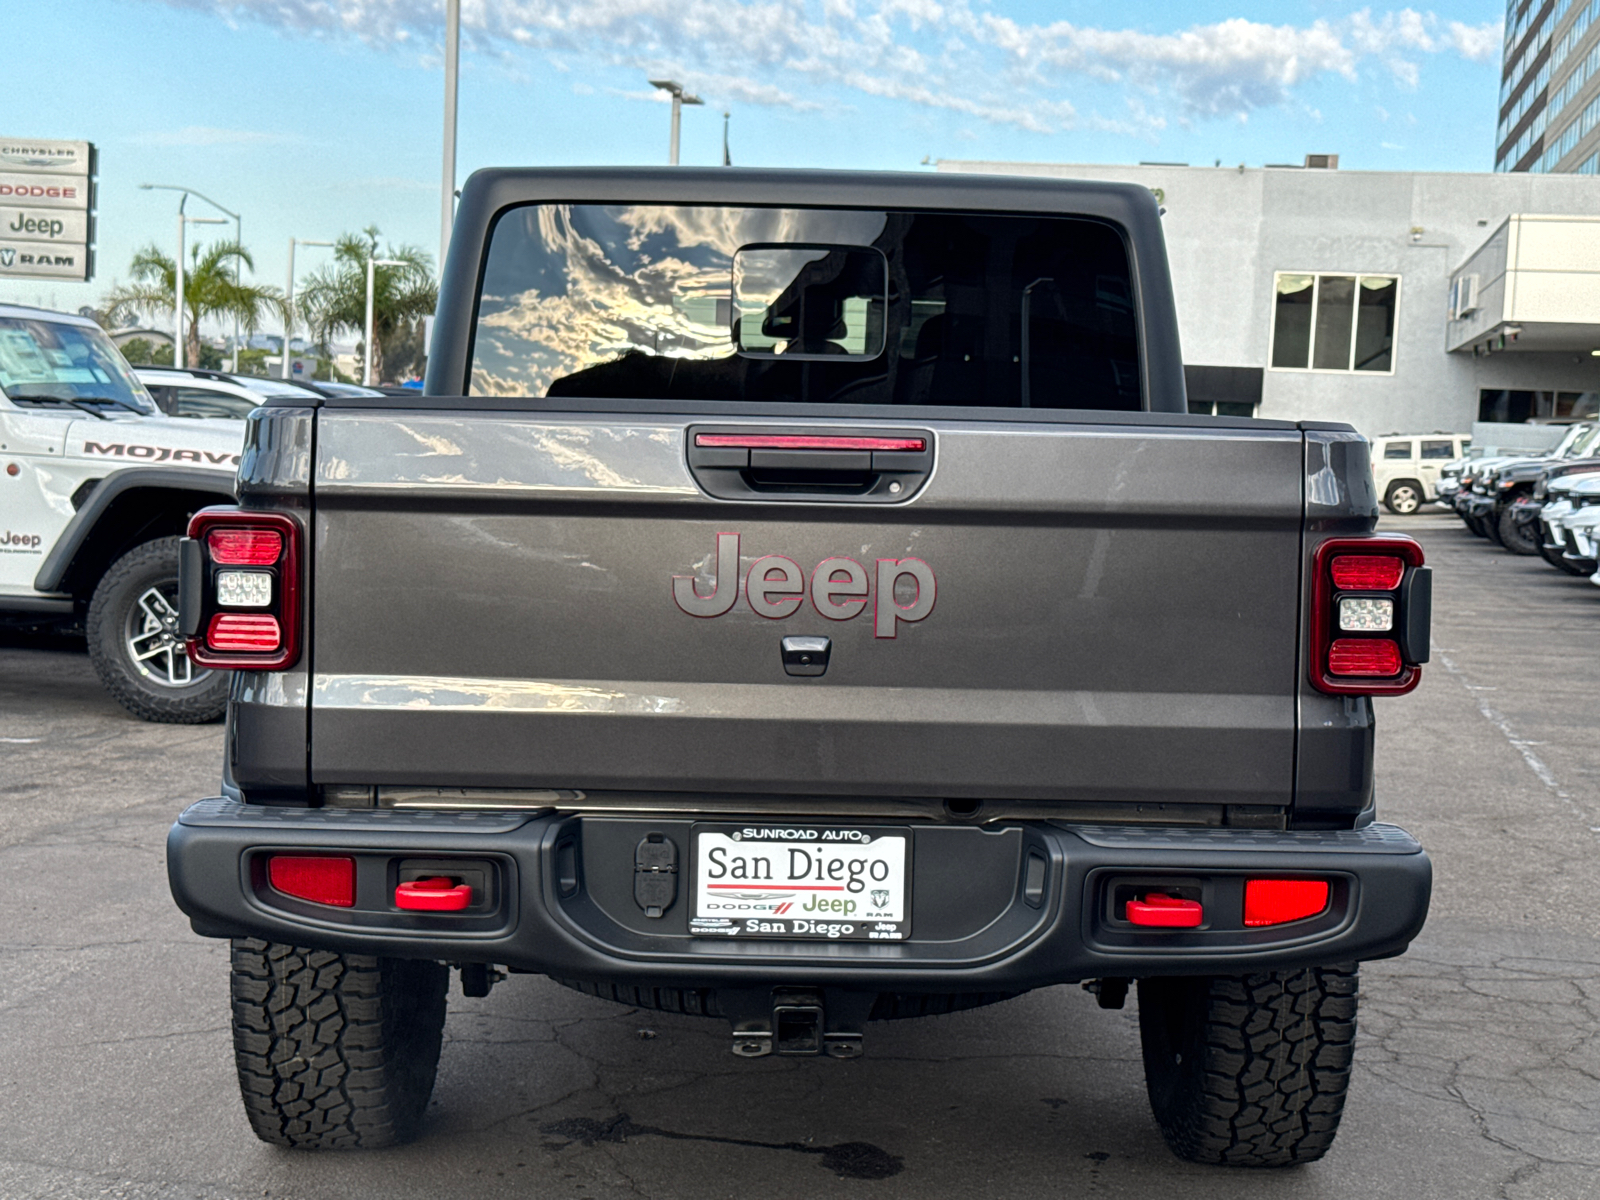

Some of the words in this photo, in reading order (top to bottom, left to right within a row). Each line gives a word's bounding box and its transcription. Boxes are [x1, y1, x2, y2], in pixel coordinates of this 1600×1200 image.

[2, 147, 75, 156] CHRYSLER
[0, 184, 77, 198] DODGE
[10, 212, 63, 238] Jeep
[20, 254, 74, 267] RAM
[0, 530, 42, 549] Jeep
[672, 532, 937, 639] Jeep
[742, 828, 818, 840] SUNROAD
[822, 830, 862, 841] AUTO
[708, 846, 774, 880] San
[787, 847, 890, 894] Diego
[706, 903, 782, 911] DODGE
[802, 894, 857, 917] Jeep
[746, 919, 787, 934] San
[792, 920, 855, 938] Diego
[874, 921, 897, 932] Jeep
